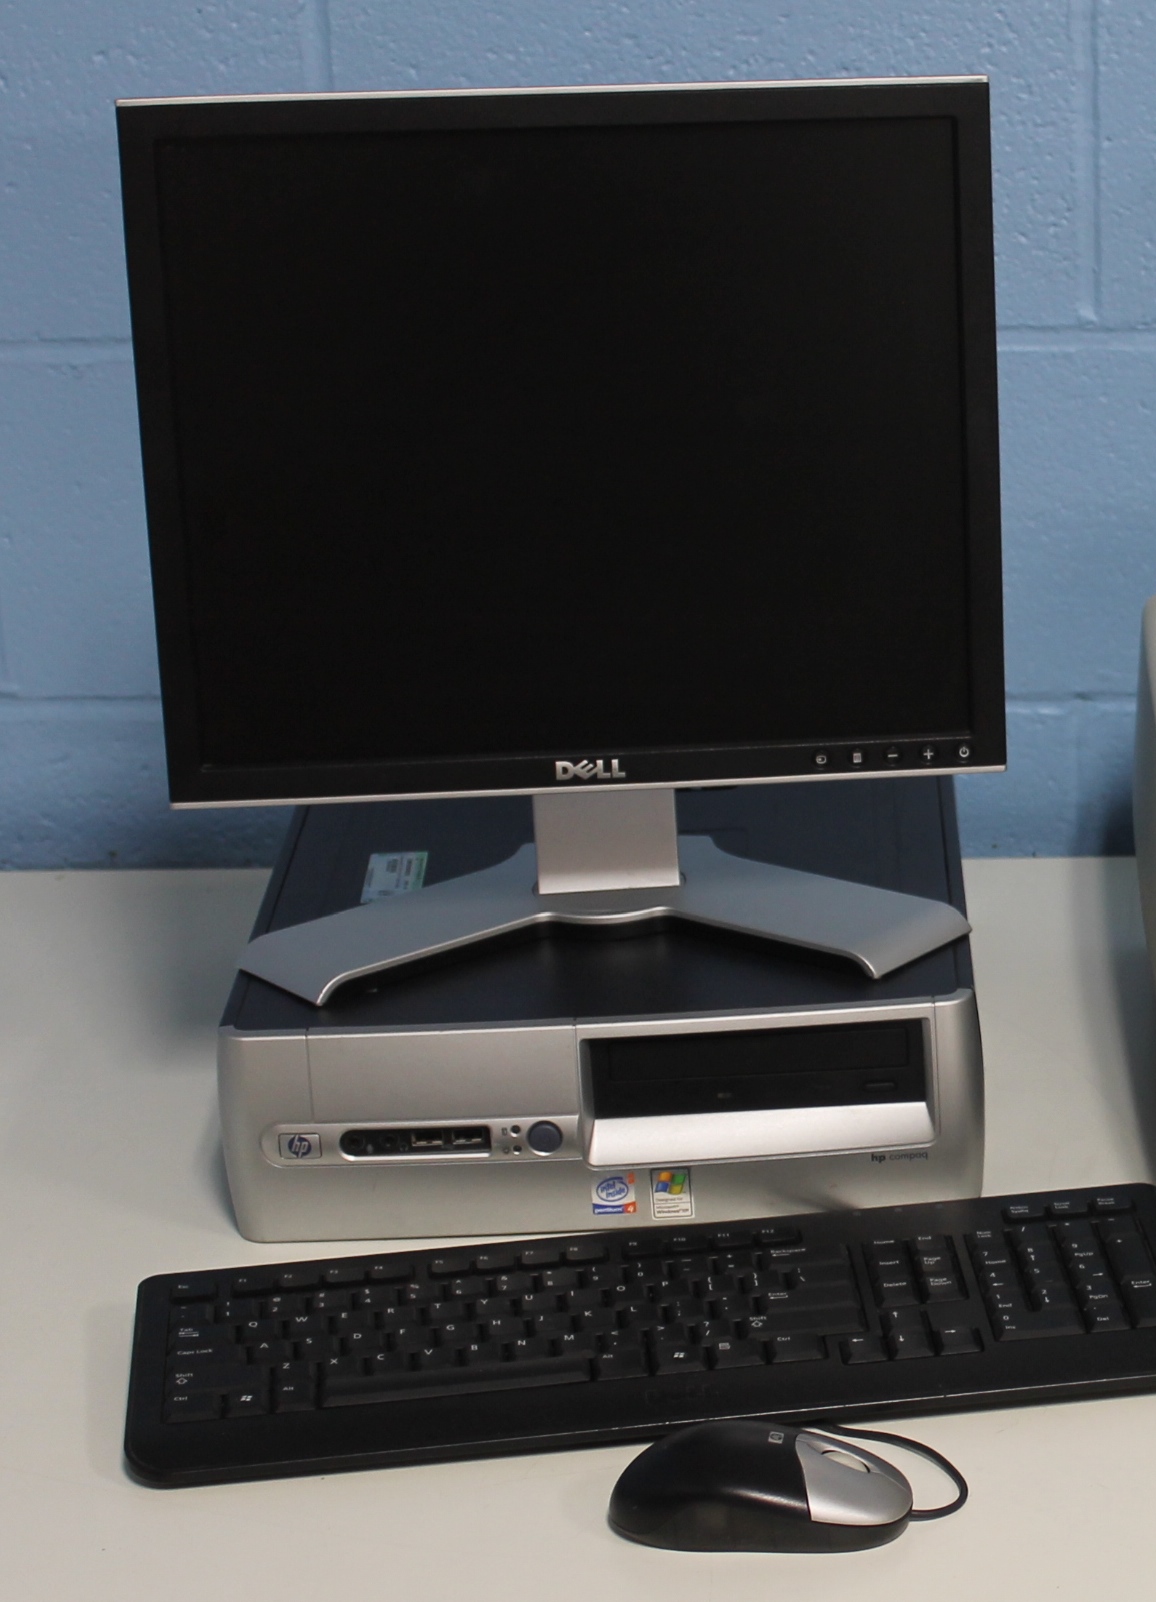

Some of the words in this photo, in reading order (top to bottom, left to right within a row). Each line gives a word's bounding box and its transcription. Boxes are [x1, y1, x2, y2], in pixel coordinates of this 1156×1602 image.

[555, 758, 626, 780] DELL
[290, 1133, 309, 1159] hp
[871, 1153, 886, 1163] hp
[889, 1151, 928, 1161] compaq
